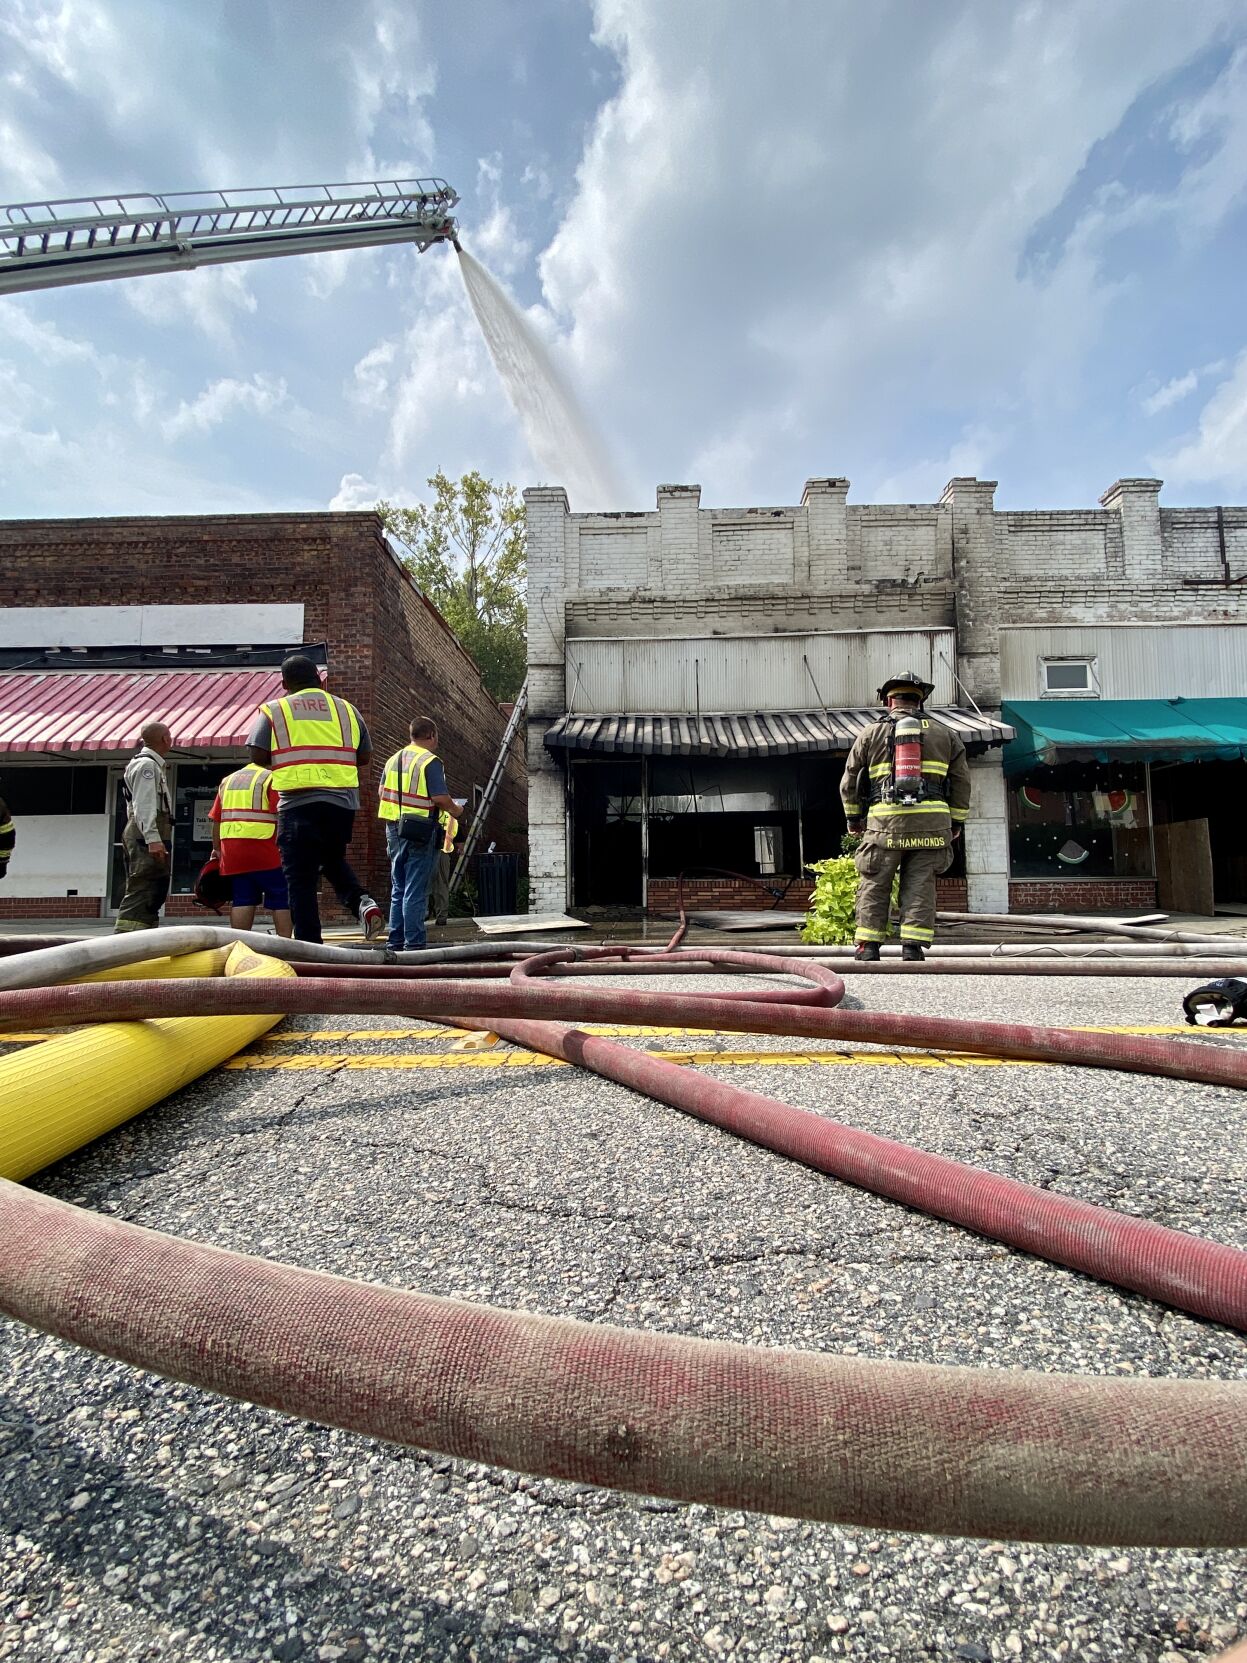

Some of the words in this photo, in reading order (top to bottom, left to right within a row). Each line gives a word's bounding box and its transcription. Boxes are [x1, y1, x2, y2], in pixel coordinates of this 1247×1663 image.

[292, 698, 328, 711] FIRE
[295, 767, 331, 782] 1712
[887, 839, 895, 848] R.
[900, 837, 945, 848] HAMMONDS
